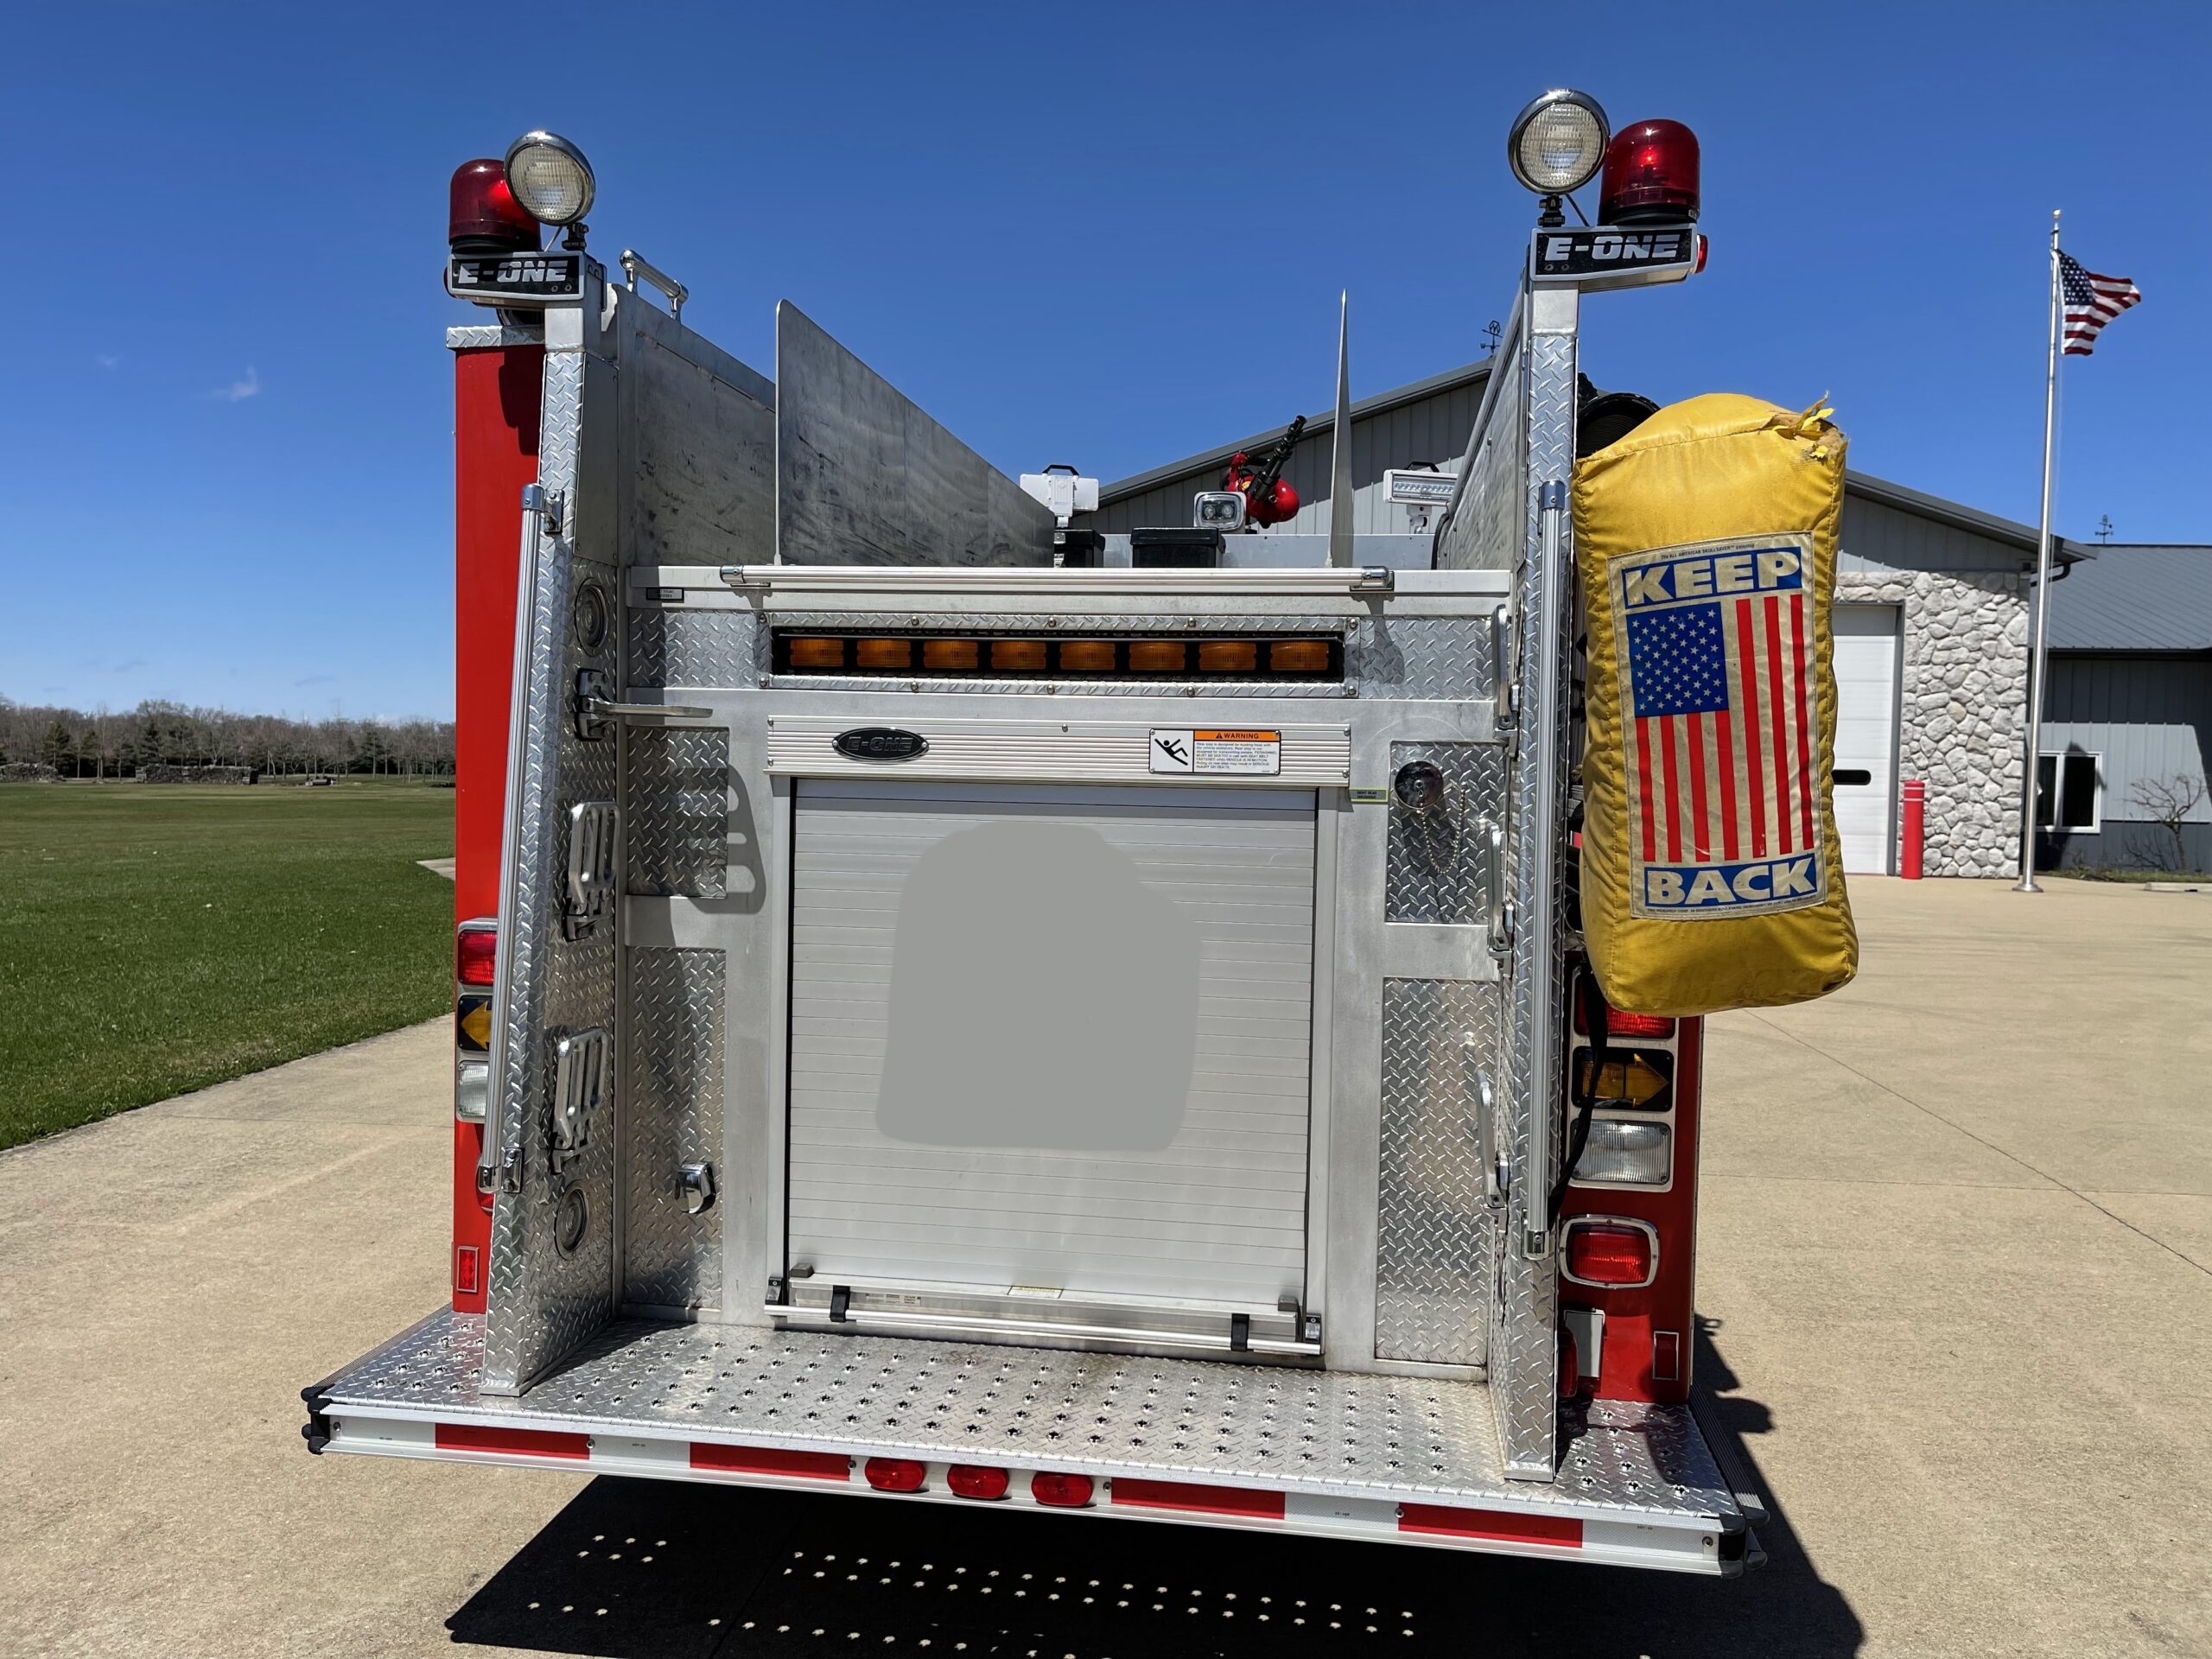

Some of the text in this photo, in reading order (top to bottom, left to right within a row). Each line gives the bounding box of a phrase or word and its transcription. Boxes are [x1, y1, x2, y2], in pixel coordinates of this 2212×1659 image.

[1545, 234, 1681, 261] E-ONE
[458, 260, 569, 283] E-ONE
[1625, 551, 1800, 606] KEEP
[846, 736, 914, 752] E-ONE
[1647, 857, 1815, 905] BACK
